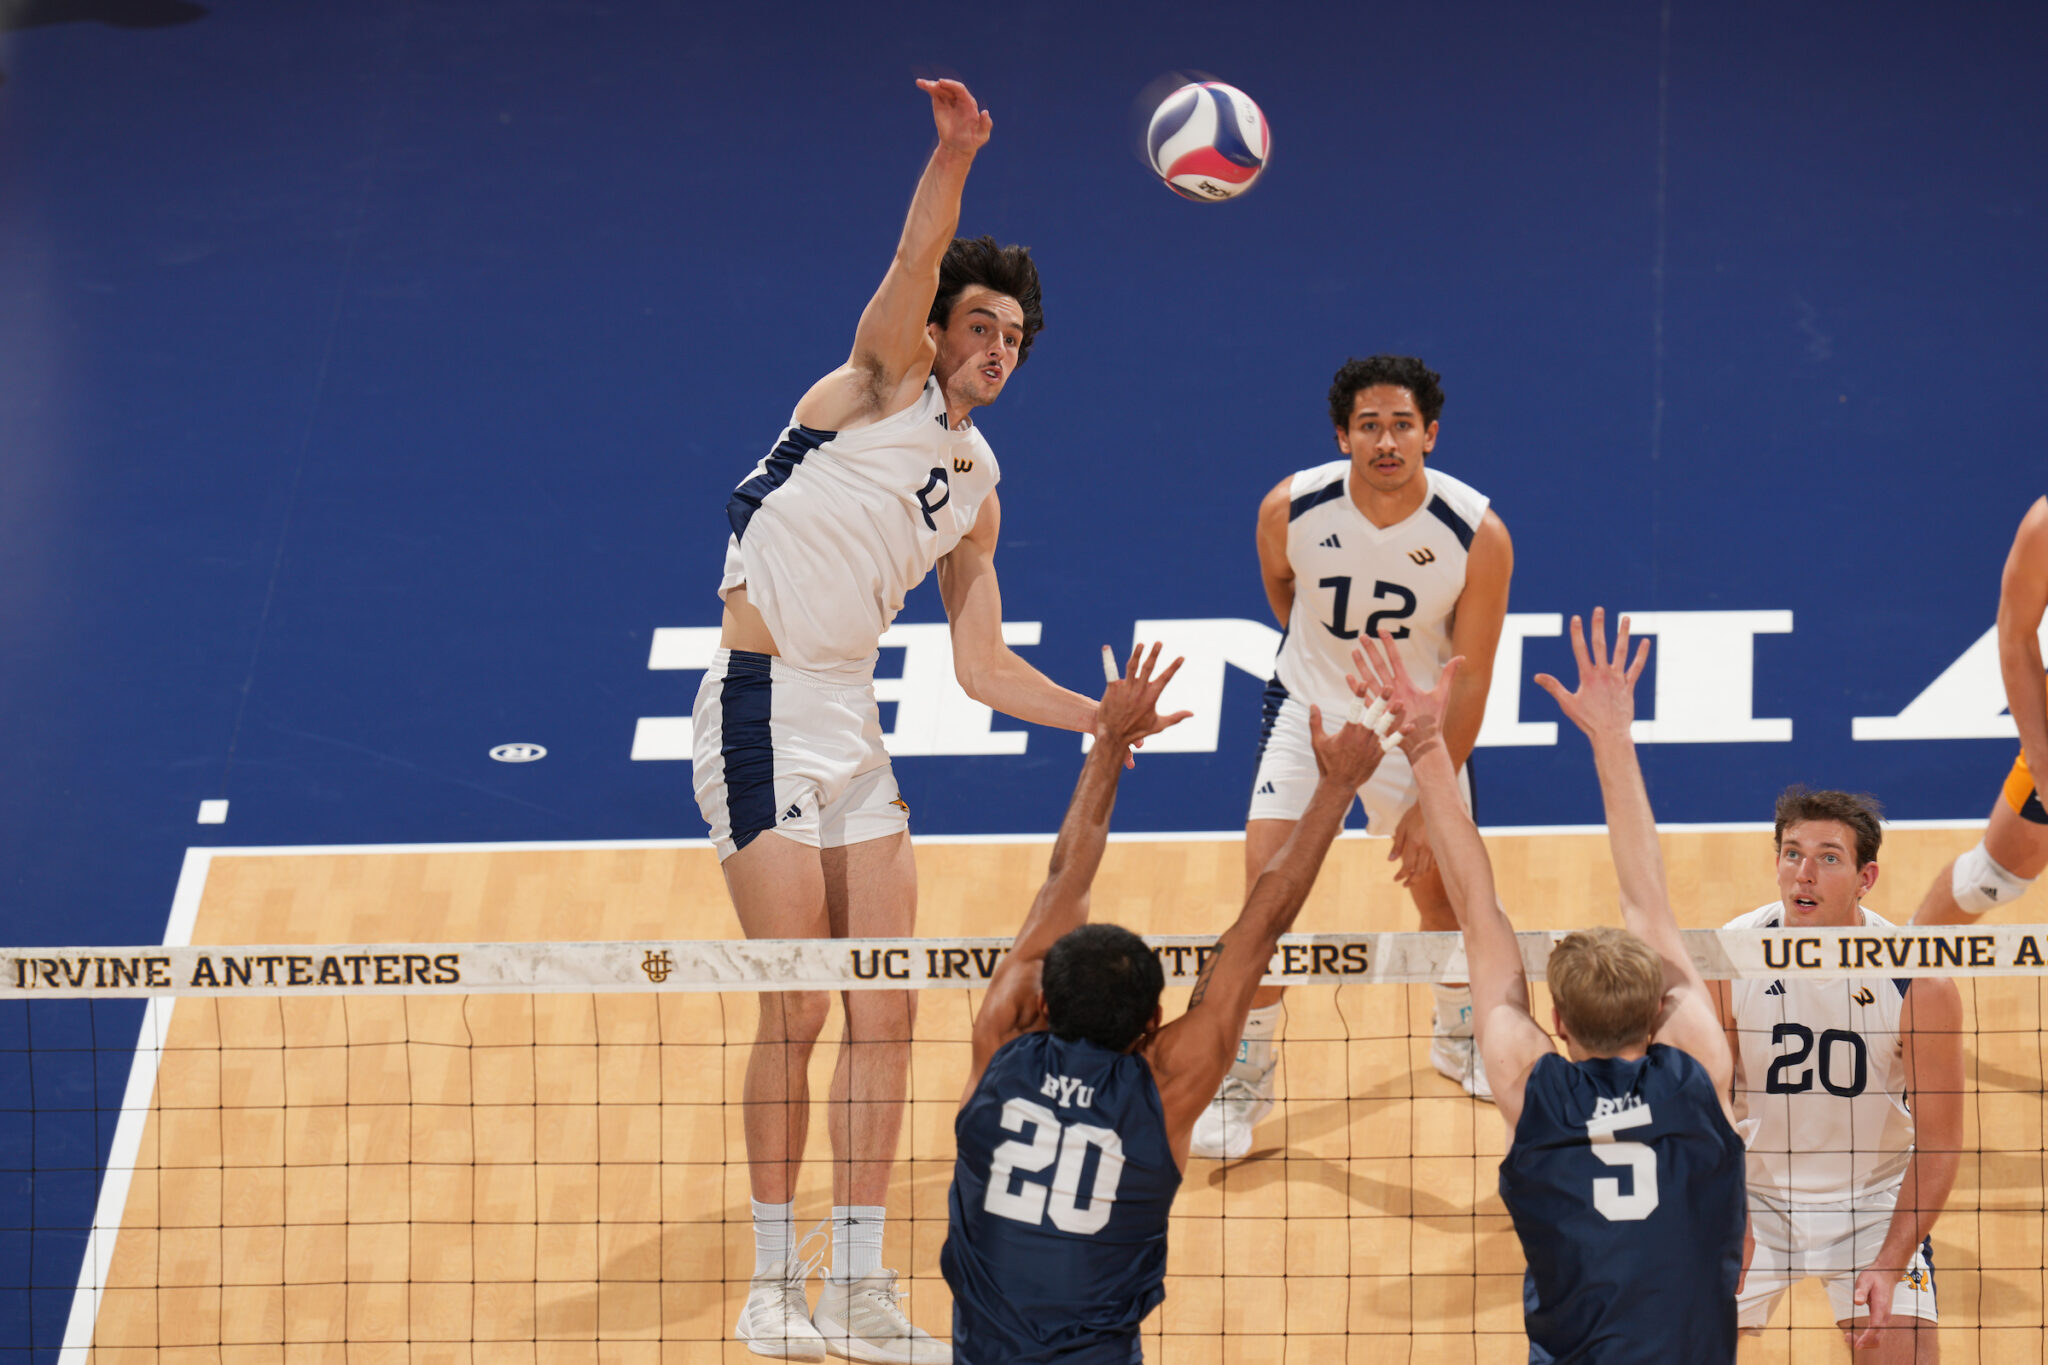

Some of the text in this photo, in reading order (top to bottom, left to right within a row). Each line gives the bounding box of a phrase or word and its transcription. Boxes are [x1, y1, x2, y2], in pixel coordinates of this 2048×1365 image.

[1319, 575, 1417, 640] 12
[15, 954, 461, 988] IRVINE ANTEATERS
[850, 948, 910, 979] UC
[925, 947, 1012, 979] IRV
[1762, 935, 2048, 969] UC IRVINE A
[1766, 1022, 1867, 1098] 20
[983, 1097, 1127, 1236] 20
[1586, 1103, 1660, 1221] 5
